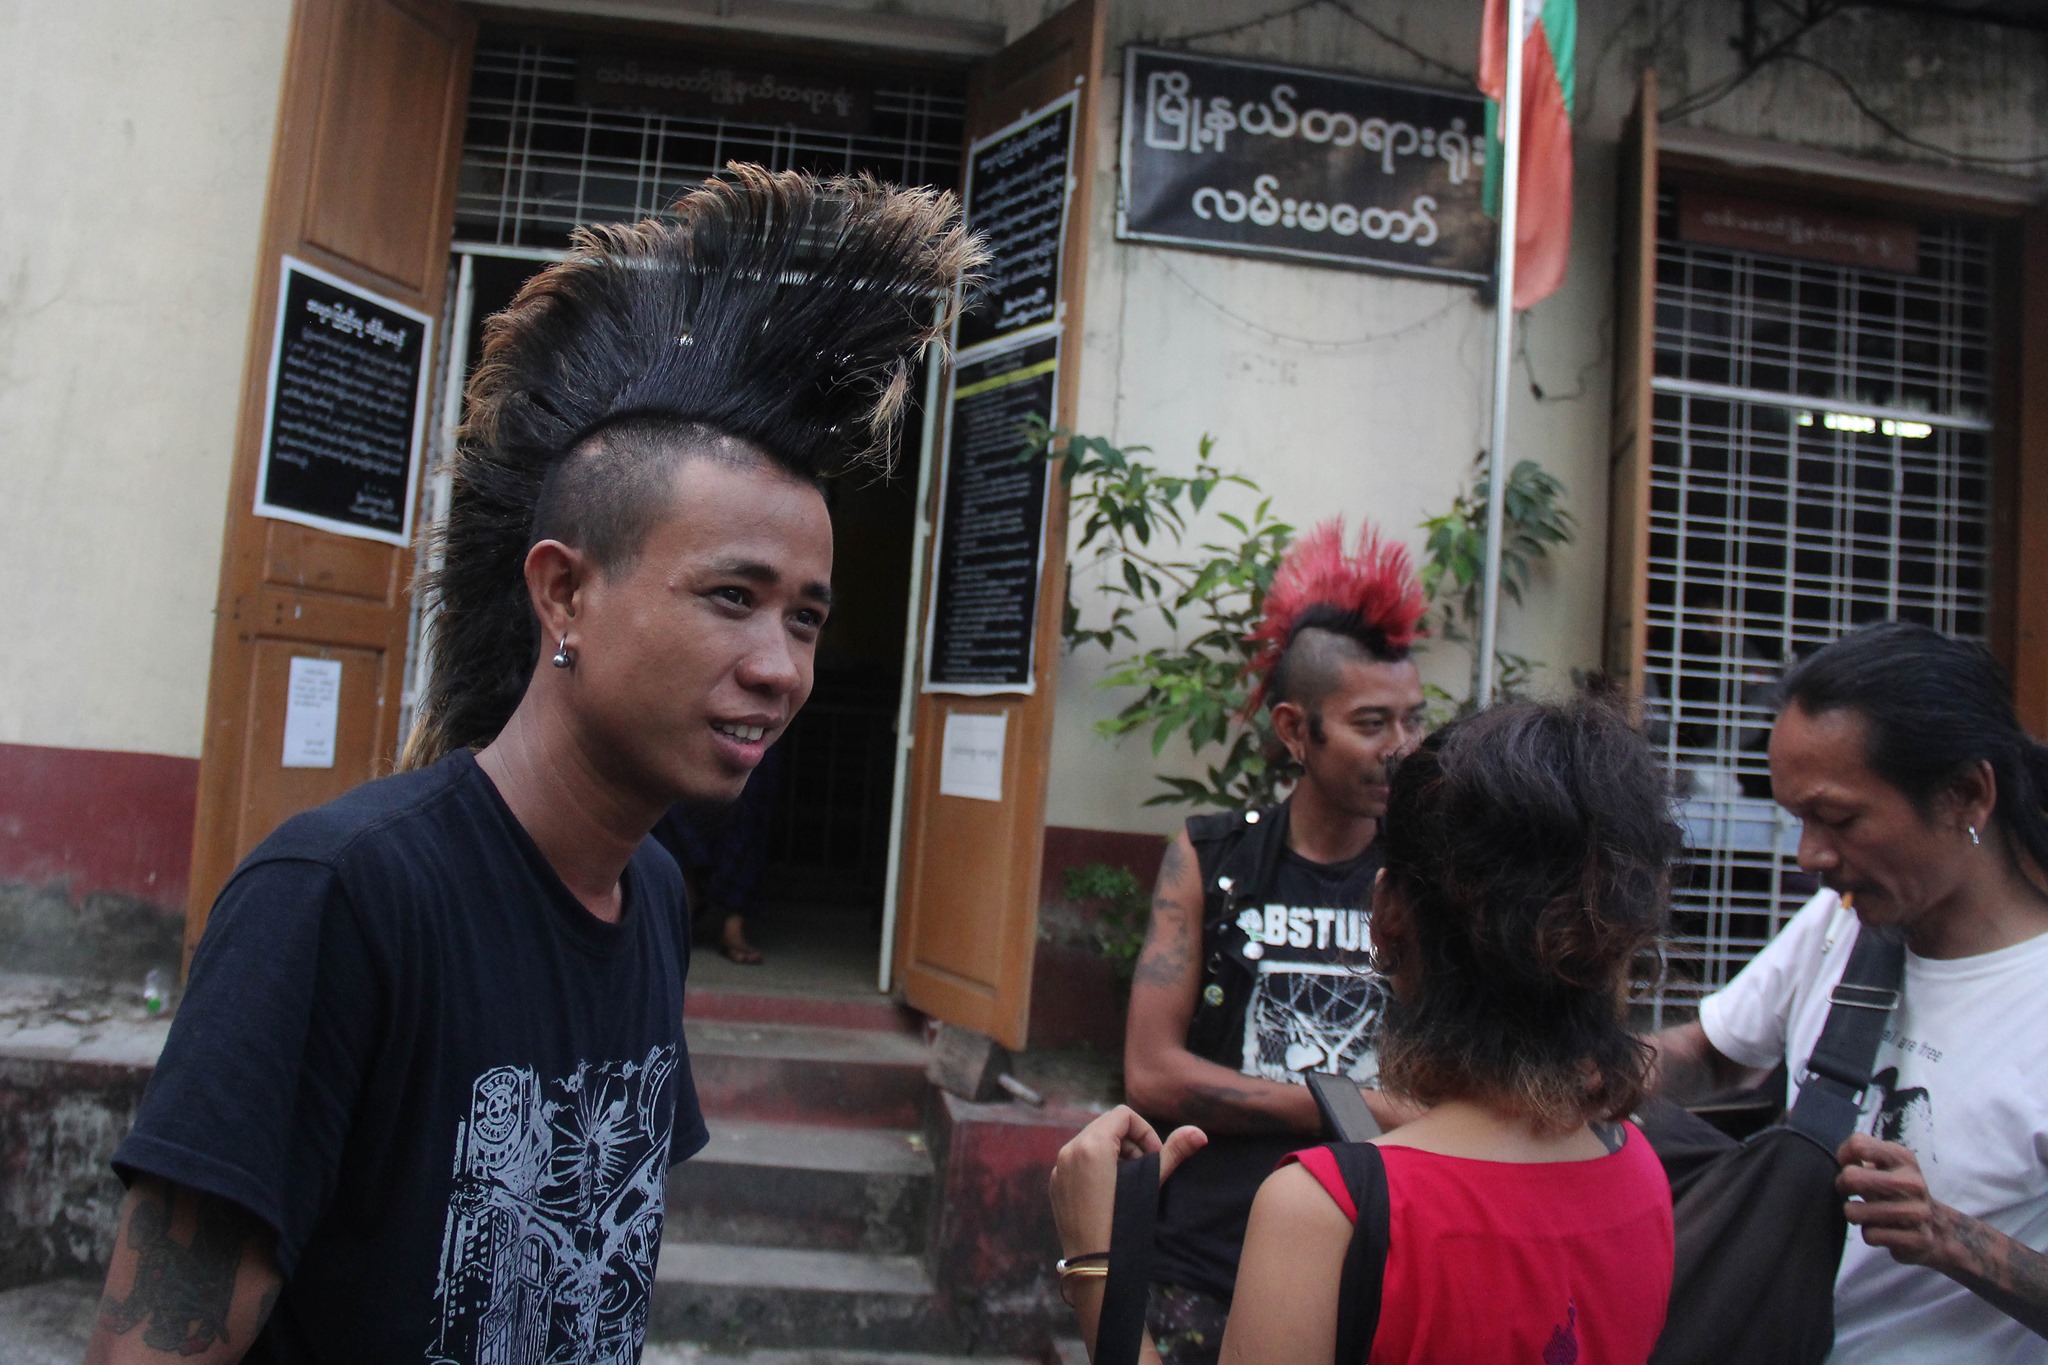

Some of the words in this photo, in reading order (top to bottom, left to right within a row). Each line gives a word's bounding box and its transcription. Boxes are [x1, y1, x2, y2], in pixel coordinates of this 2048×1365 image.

[1192, 174, 1439, 246] လမ်းမတော်
[1238, 904, 1373, 952] BSTU
